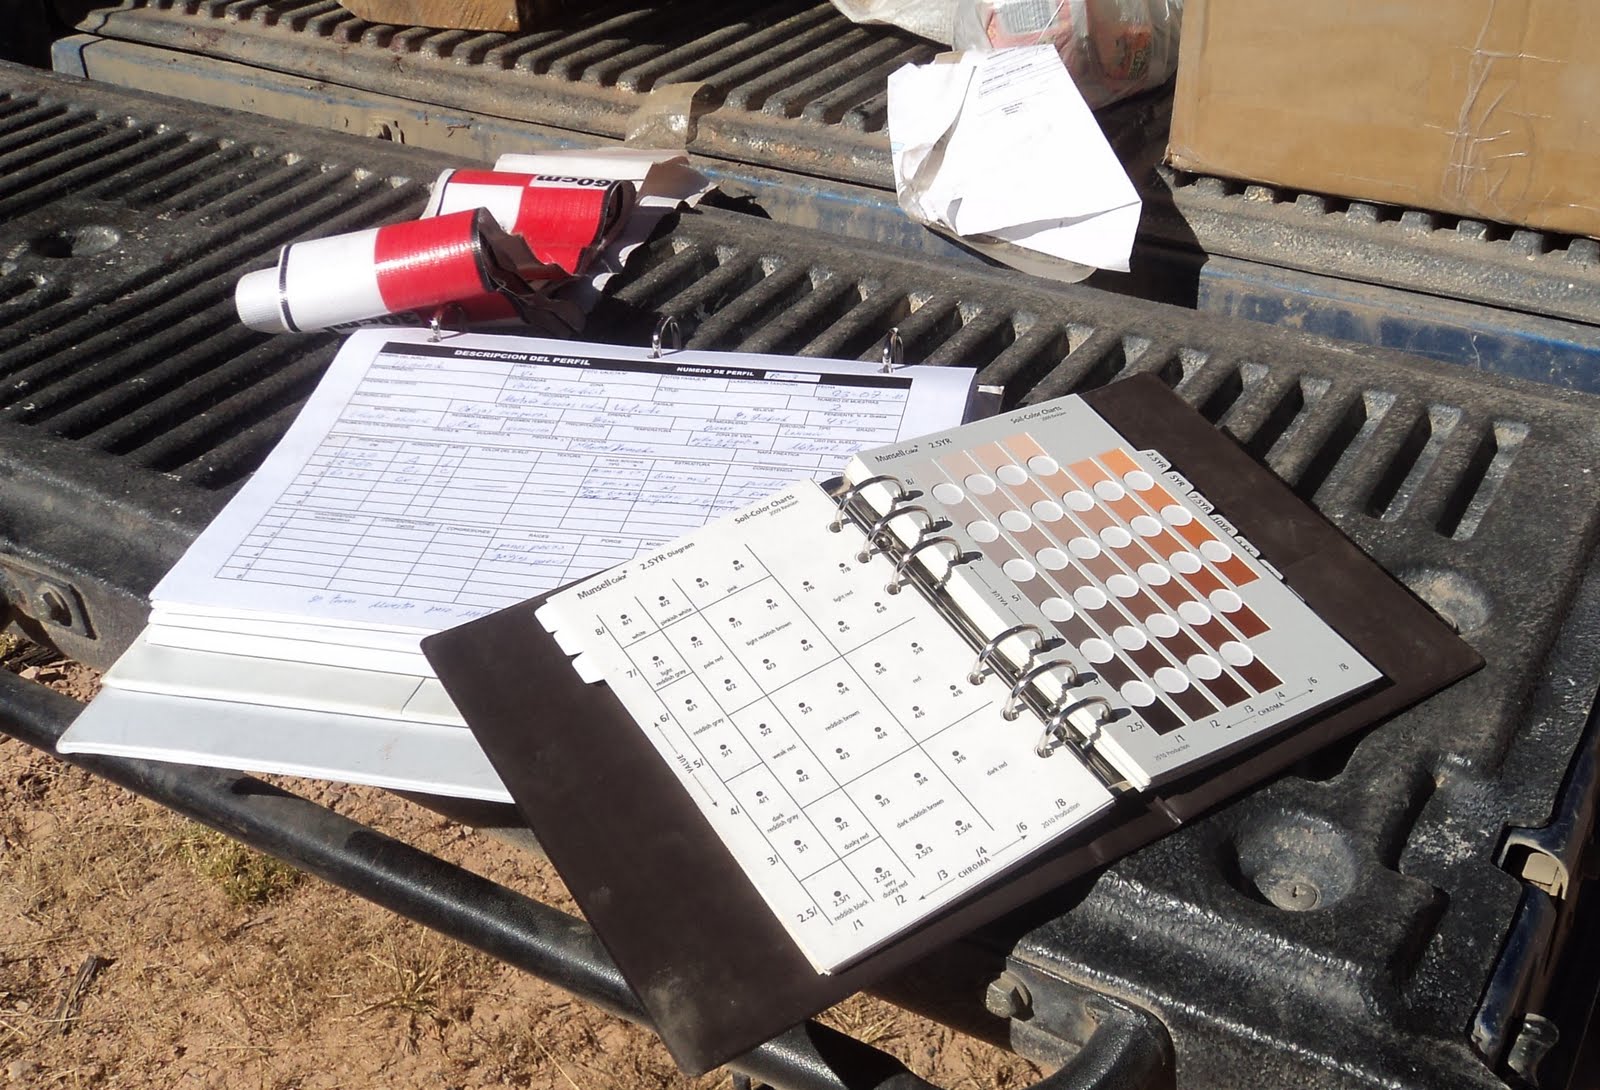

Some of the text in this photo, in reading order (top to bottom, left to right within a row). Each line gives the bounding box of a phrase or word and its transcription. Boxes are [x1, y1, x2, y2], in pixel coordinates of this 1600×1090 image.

[537, 175, 612, 187] 60cm
[454, 349, 527, 361] DESCRIPCION
[552, 357, 591, 365] PERFIL
[676, 366, 711, 374] NUMERO
[1041, 405, 1062, 415] Charts
[928, 438, 952, 449] 2.5YR
[875, 450, 905, 463] Munsell
[1146, 452, 1167, 469] 2.5YR
[1170, 475, 1185, 487] 5YR
[735, 494, 795, 524] Soil-Color Charts
[1191, 494, 1211, 512] 7.5YR
[1212, 517, 1232, 533] 10YR
[640, 542, 695, 570] 2.5YR Diagram
[577, 579, 612, 599] Munsell
[595, 626, 605, 636] 8/
[692, 640, 703, 648] 7/2
[626, 668, 637, 678] 7/
[1308, 676, 1317, 685] /6
[1275, 691, 1285, 700] /4
[1244, 705, 1254, 714] /3
[1257, 702, 1285, 716] CHROMA
[659, 713, 670, 723] 6/
[1209, 719, 1220, 728] /2
[760, 727, 772, 737] 5/2
[1127, 721, 1145, 733] 2.5/
[1175, 734, 1186, 743] /1
[721, 748, 733, 758] 5/1
[676, 754, 694, 774] VALUE
[693, 758, 704, 768] 5/
[878, 798, 890, 807] 3/3
[1055, 798, 1066, 810] /8
[730, 805, 740, 816] 4/
[1041, 802, 1080, 828] 2010 Production
[837, 821, 849, 831] 3/2
[955, 823, 973, 836] 2.5/4
[1016, 822, 1028, 833] /6
[797, 844, 808, 854] 3/1
[915, 846, 933, 859] 2.5/3
[976, 846, 987, 858] /4
[767, 854, 779, 866] 3/
[958, 857, 991, 878] CHROMA
[874, 870, 892, 884] 2.5/2
[937, 869, 948, 881] /3
[833, 894, 851, 907] 2.5/1
[895, 894, 907, 906] /2
[797, 906, 818, 923] 2.5/
[834, 899, 869, 922] reddish black
[853, 919, 864, 930] /1
